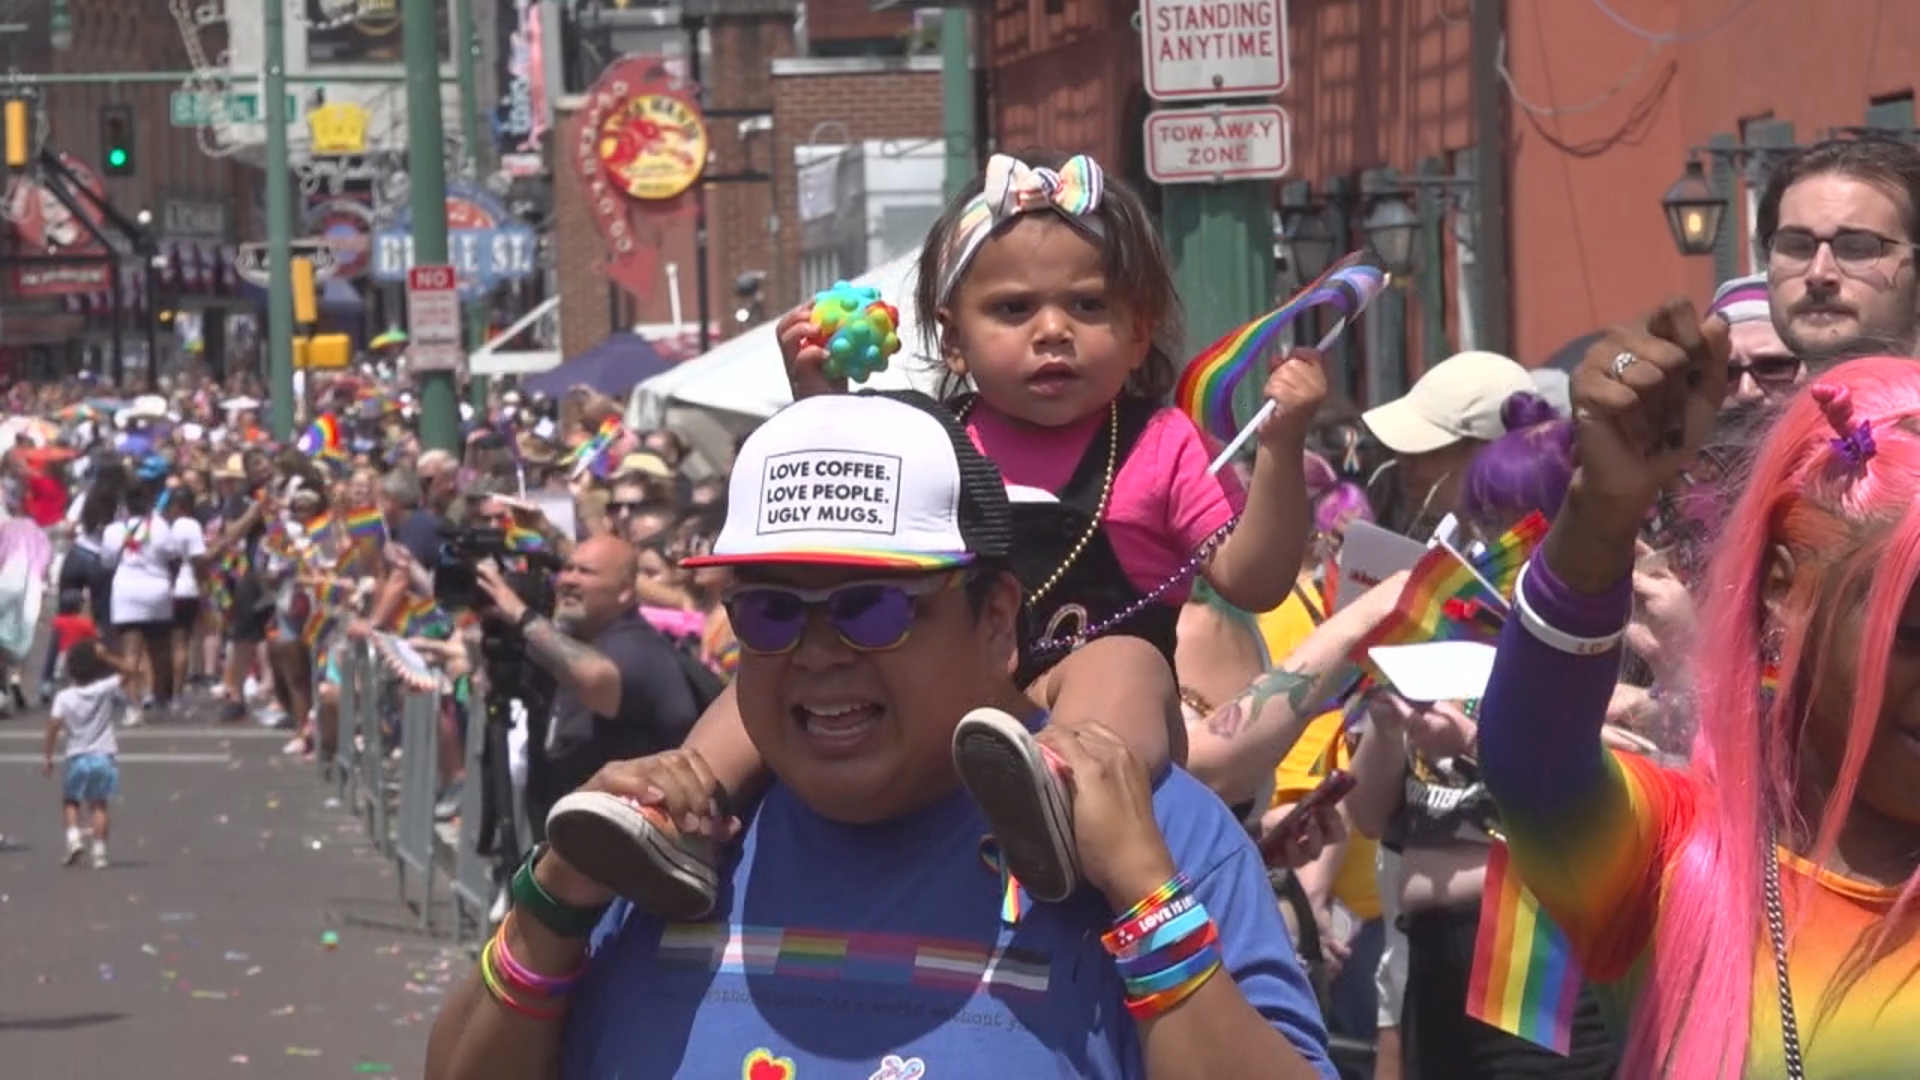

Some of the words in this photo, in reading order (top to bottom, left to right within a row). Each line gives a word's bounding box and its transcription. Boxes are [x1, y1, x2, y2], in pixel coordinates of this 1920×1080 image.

[1156, 2, 1272, 32] STANDING
[1159, 31, 1272, 61] ANYTIME
[1159, 119, 1273, 144] TOW-AWAY
[1187, 145, 1248, 165] ZONE
[415, 270, 448, 287] NO
[770, 461, 810, 481] LOVE
[815, 460, 891, 481] COFFEE.
[766, 484, 807, 504] LOVE
[812, 483, 889, 504] PEOPLE.
[767, 506, 811, 525] UGLY
[816, 505, 883, 525] MUGS.
[1138, 906, 1173, 933] LOVE
[1170, 900, 1183, 916] IS
